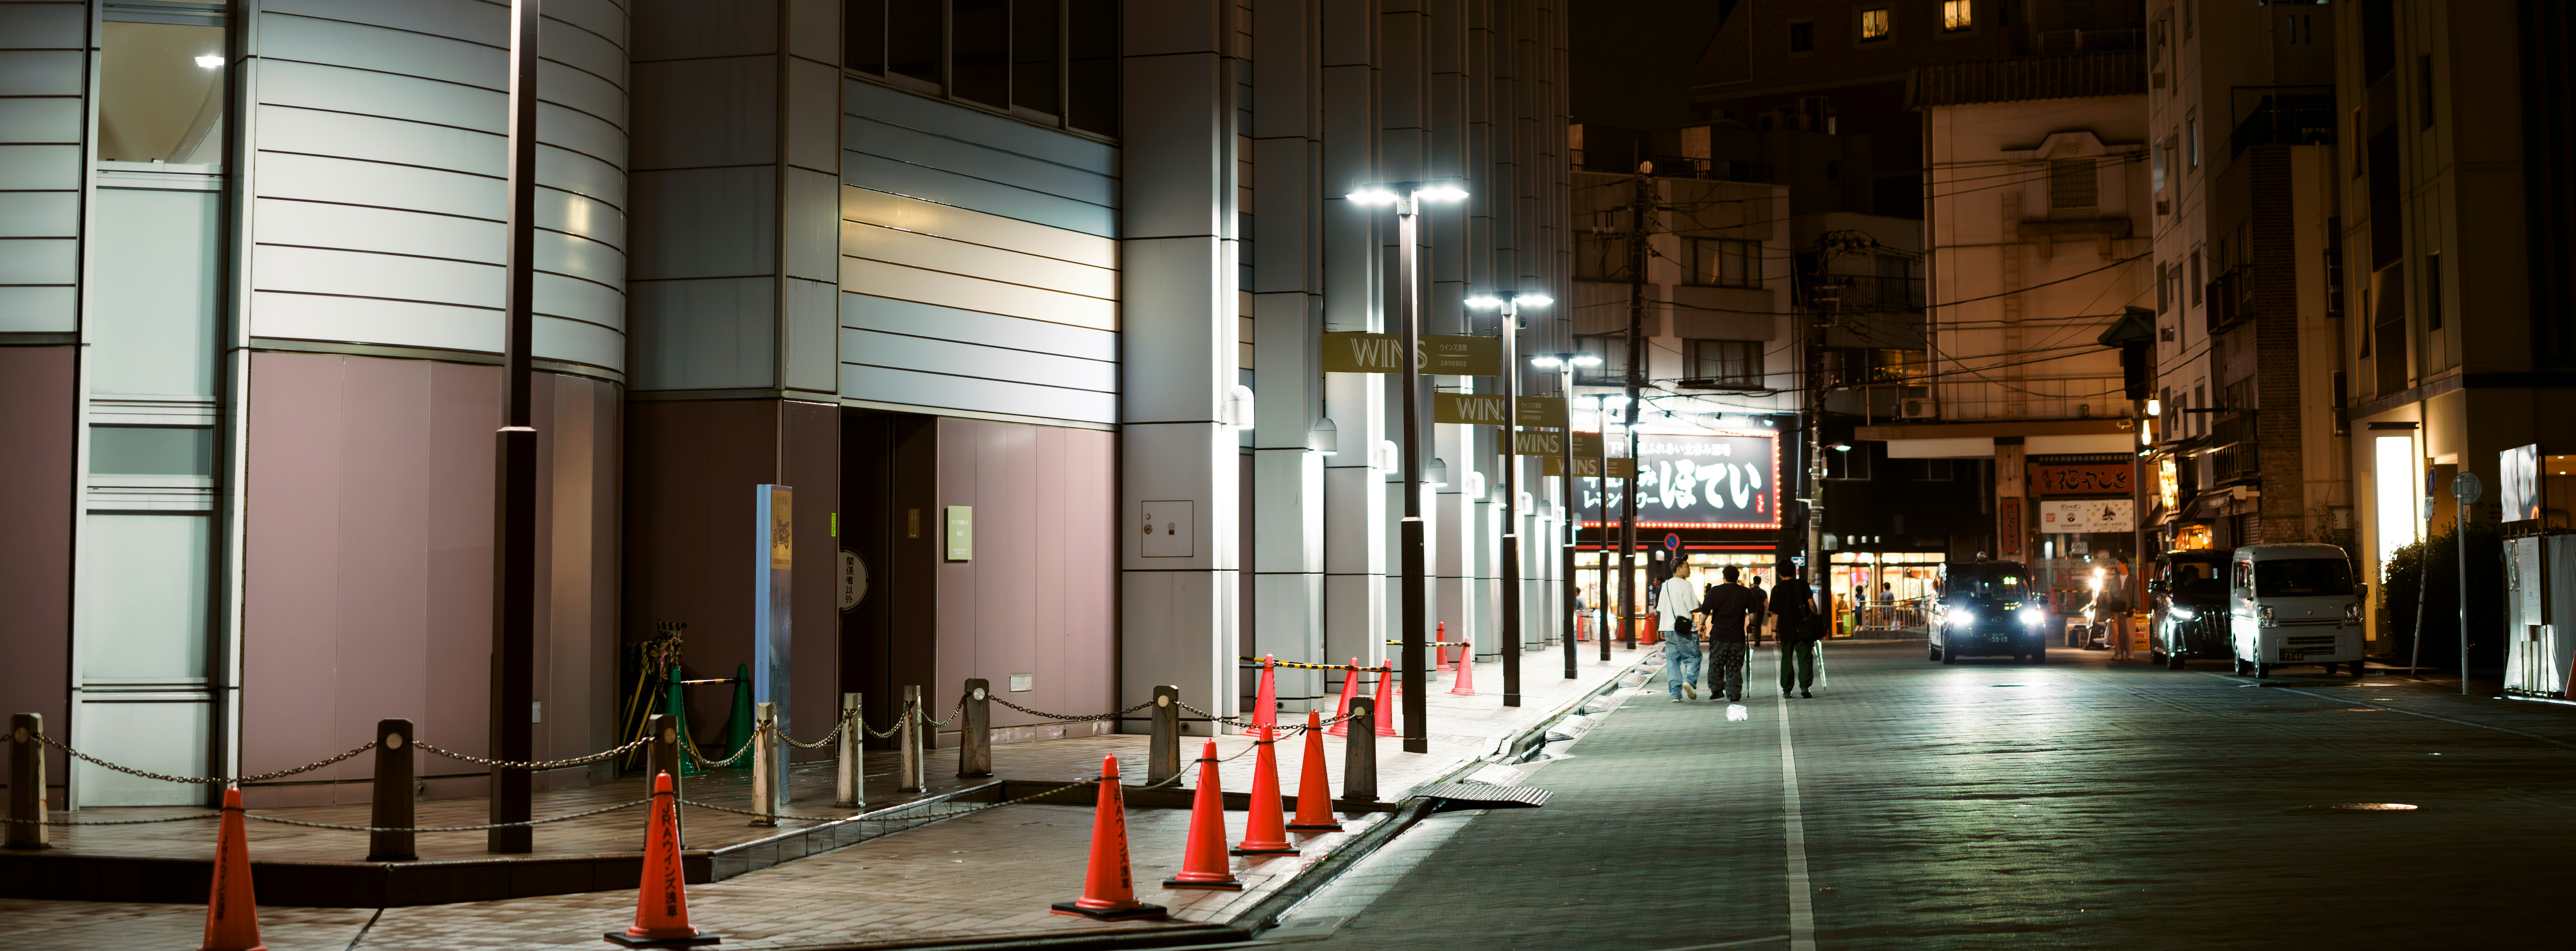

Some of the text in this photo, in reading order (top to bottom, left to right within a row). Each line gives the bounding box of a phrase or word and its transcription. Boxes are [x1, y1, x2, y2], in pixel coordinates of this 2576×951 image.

[1516, 434, 1559, 453] WINS
[1660, 459, 1761, 509] ほてい
[845, 557, 854, 604] 関係者以外
